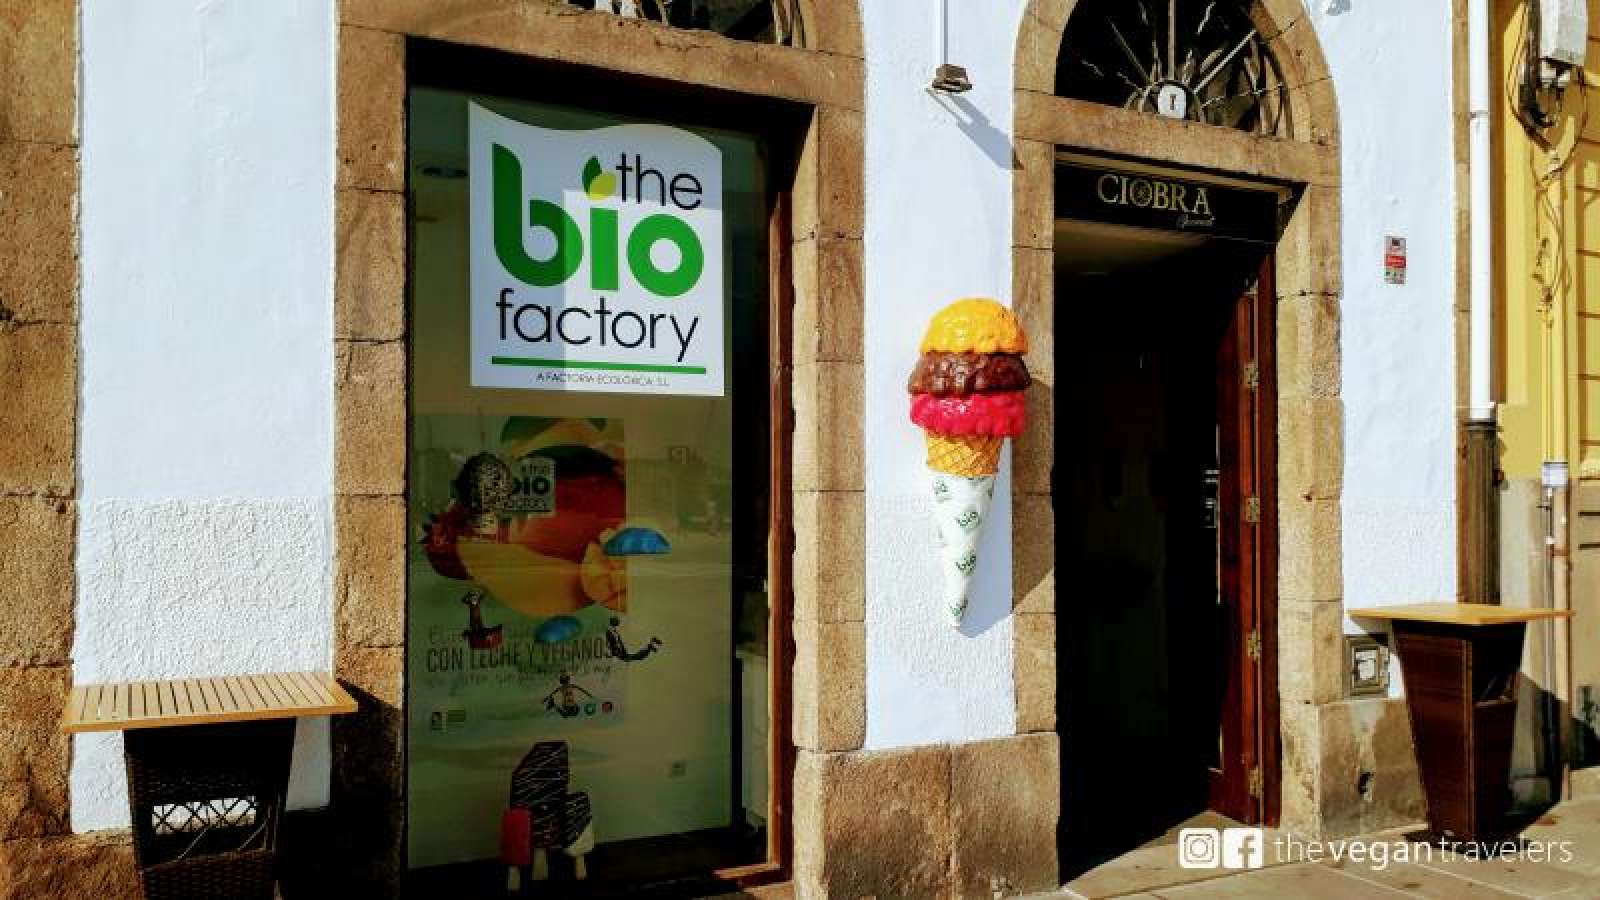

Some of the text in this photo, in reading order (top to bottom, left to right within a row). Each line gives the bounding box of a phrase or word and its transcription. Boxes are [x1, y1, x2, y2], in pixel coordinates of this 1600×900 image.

[616, 152, 703, 210] the
[1098, 174, 1211, 213] CIOBRA
[492, 142, 704, 297] bio
[495, 287, 699, 362] factory
[427, 647, 463, 673] CON
